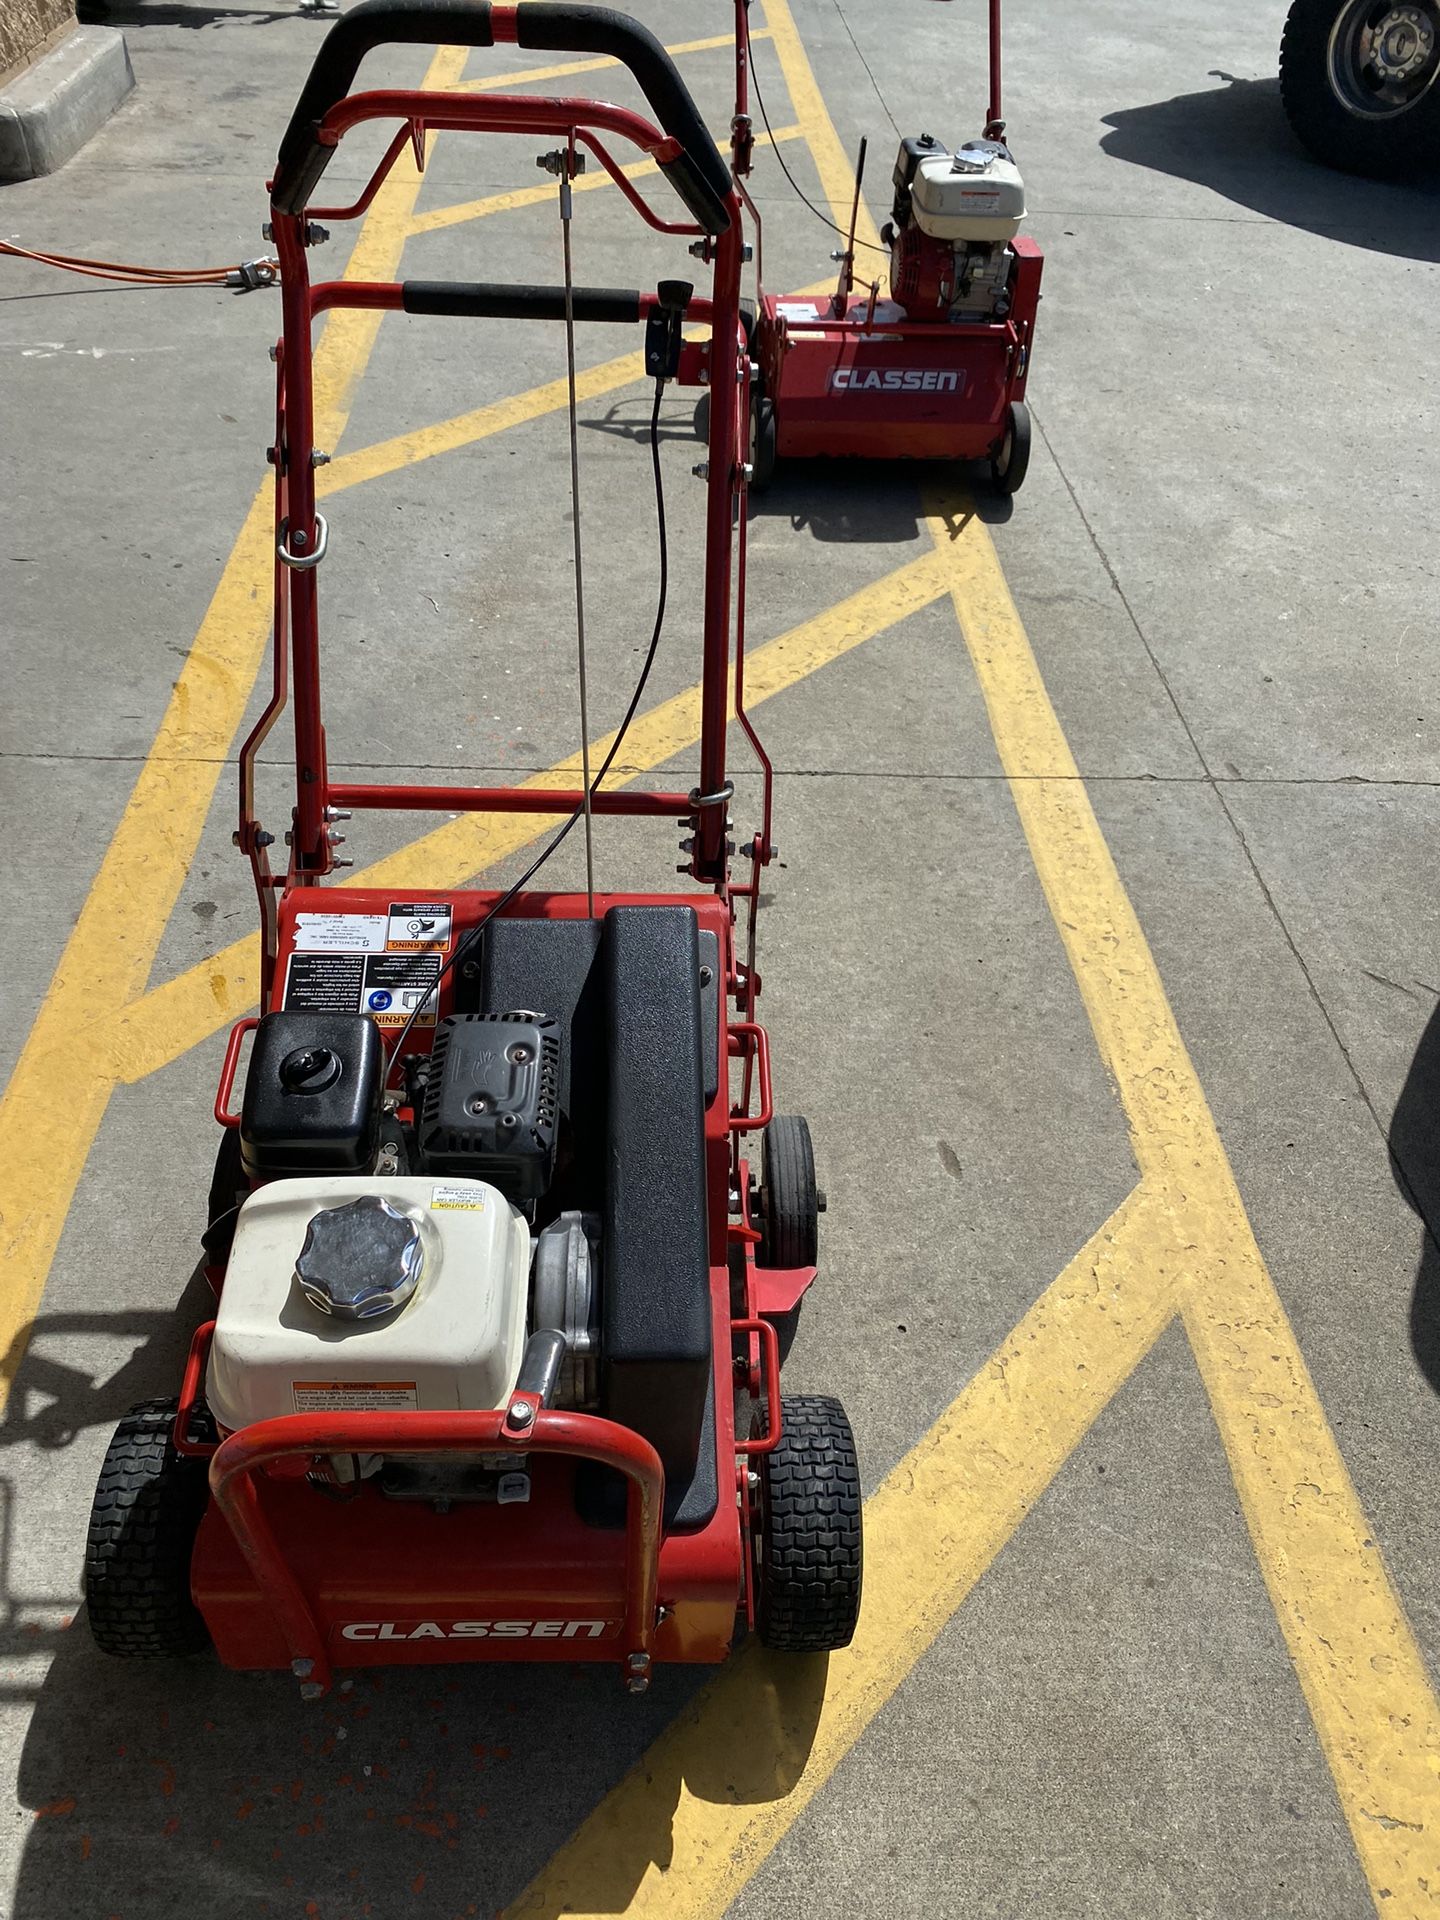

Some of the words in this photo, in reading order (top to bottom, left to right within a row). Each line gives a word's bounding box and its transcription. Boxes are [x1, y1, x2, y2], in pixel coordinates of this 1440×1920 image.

[832, 369, 958, 390] CLASSEN
[374, 1015, 417, 1024] ARNIN
[342, 1621, 606, 1640] CLASSEN
